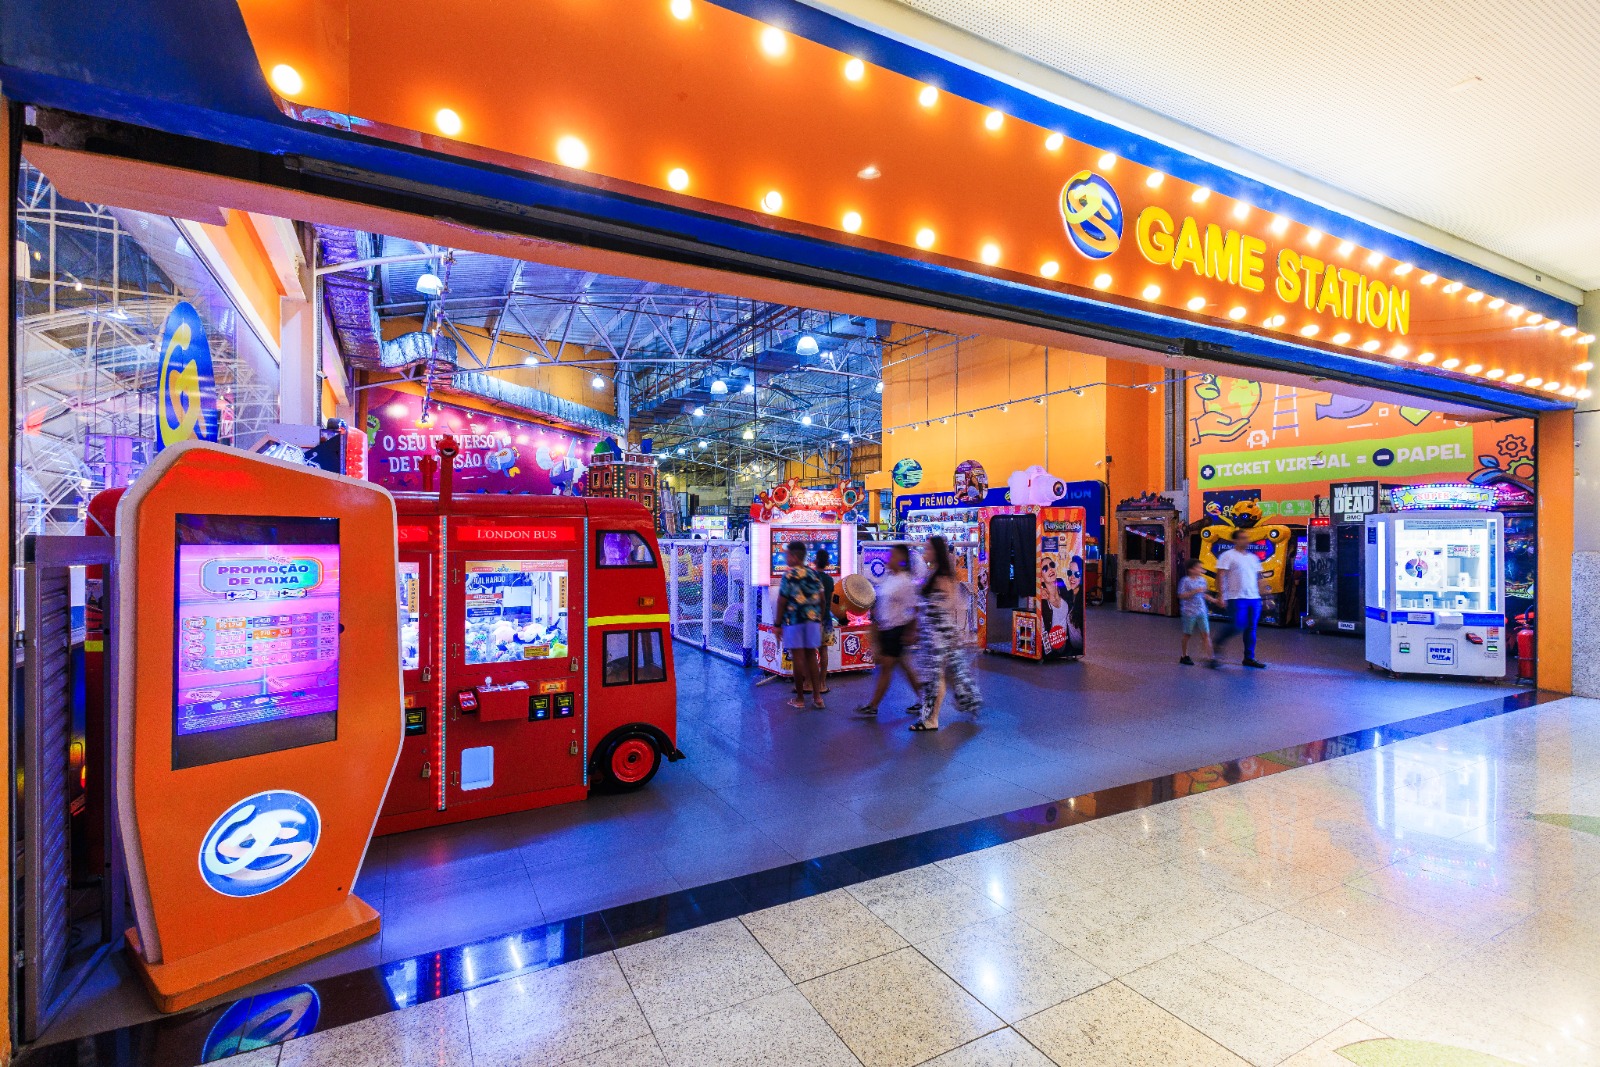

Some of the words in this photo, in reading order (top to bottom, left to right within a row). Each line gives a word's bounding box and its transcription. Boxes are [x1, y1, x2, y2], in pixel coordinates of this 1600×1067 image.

[1135, 205, 1268, 292] GAME
[1275, 248, 1410, 335] STATION
[383, 435, 395, 451] O
[398, 433, 427, 451] SEU
[429, 434, 496, 451] UVERSO
[388, 455, 411, 473] DE
[1215, 459, 1269, 477] TICKET
[1276, 453, 1351, 473] VIRTUAL
[1397, 444, 1467, 463] PAPEL
[1334, 486, 1374, 498] WALKING
[1334, 496, 1375, 513] DEAD
[477, 529, 530, 539] LONDON
[534, 530, 557, 539] BUS
[218, 563, 310, 575] PROMOÇÃO
[228, 577, 250, 586] DE
[254, 575, 300, 585] CAIXA
